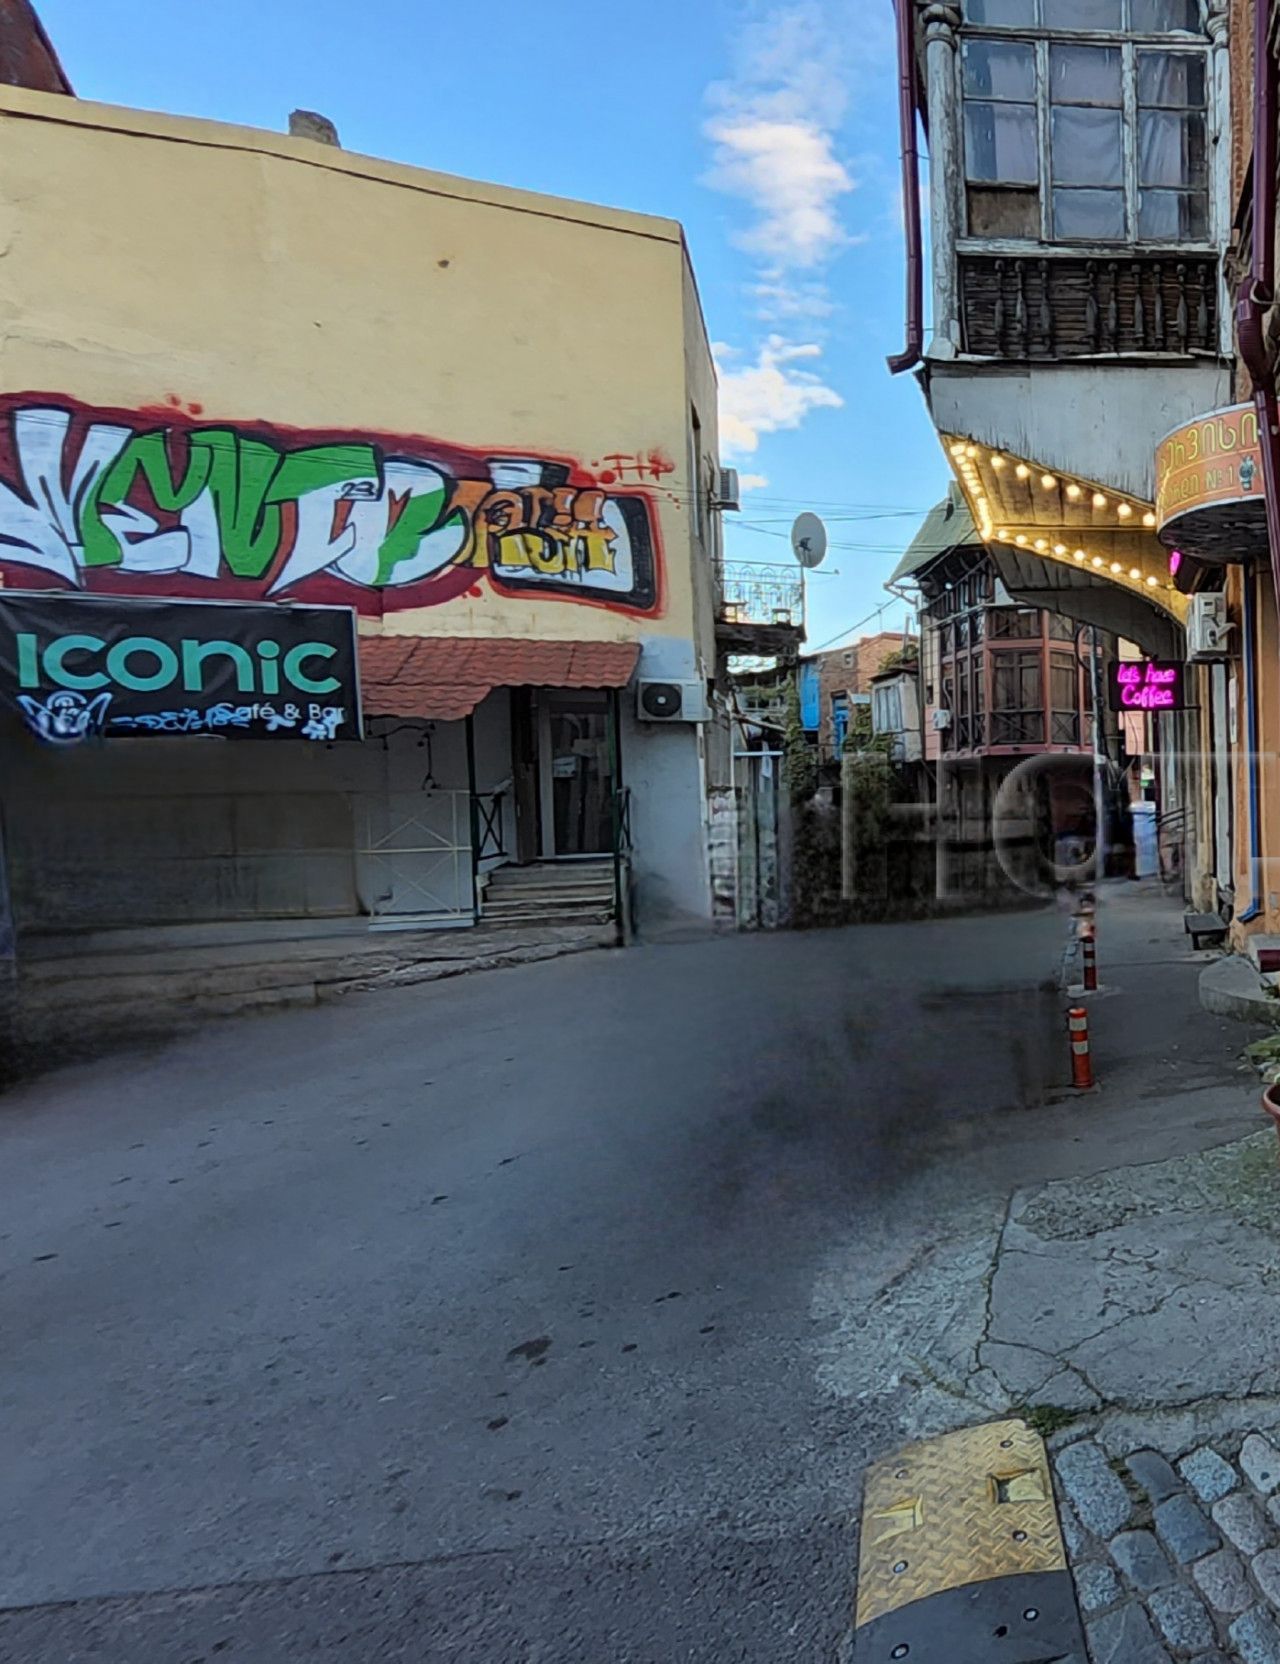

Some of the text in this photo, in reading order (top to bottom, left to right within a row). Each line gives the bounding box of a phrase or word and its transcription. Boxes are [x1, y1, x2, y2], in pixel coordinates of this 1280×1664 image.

[1121, 684, 1174, 708] Coffee
[218, 702, 275, 720] Café
[283, 703, 302, 720] &
[309, 703, 345, 720] Bar
